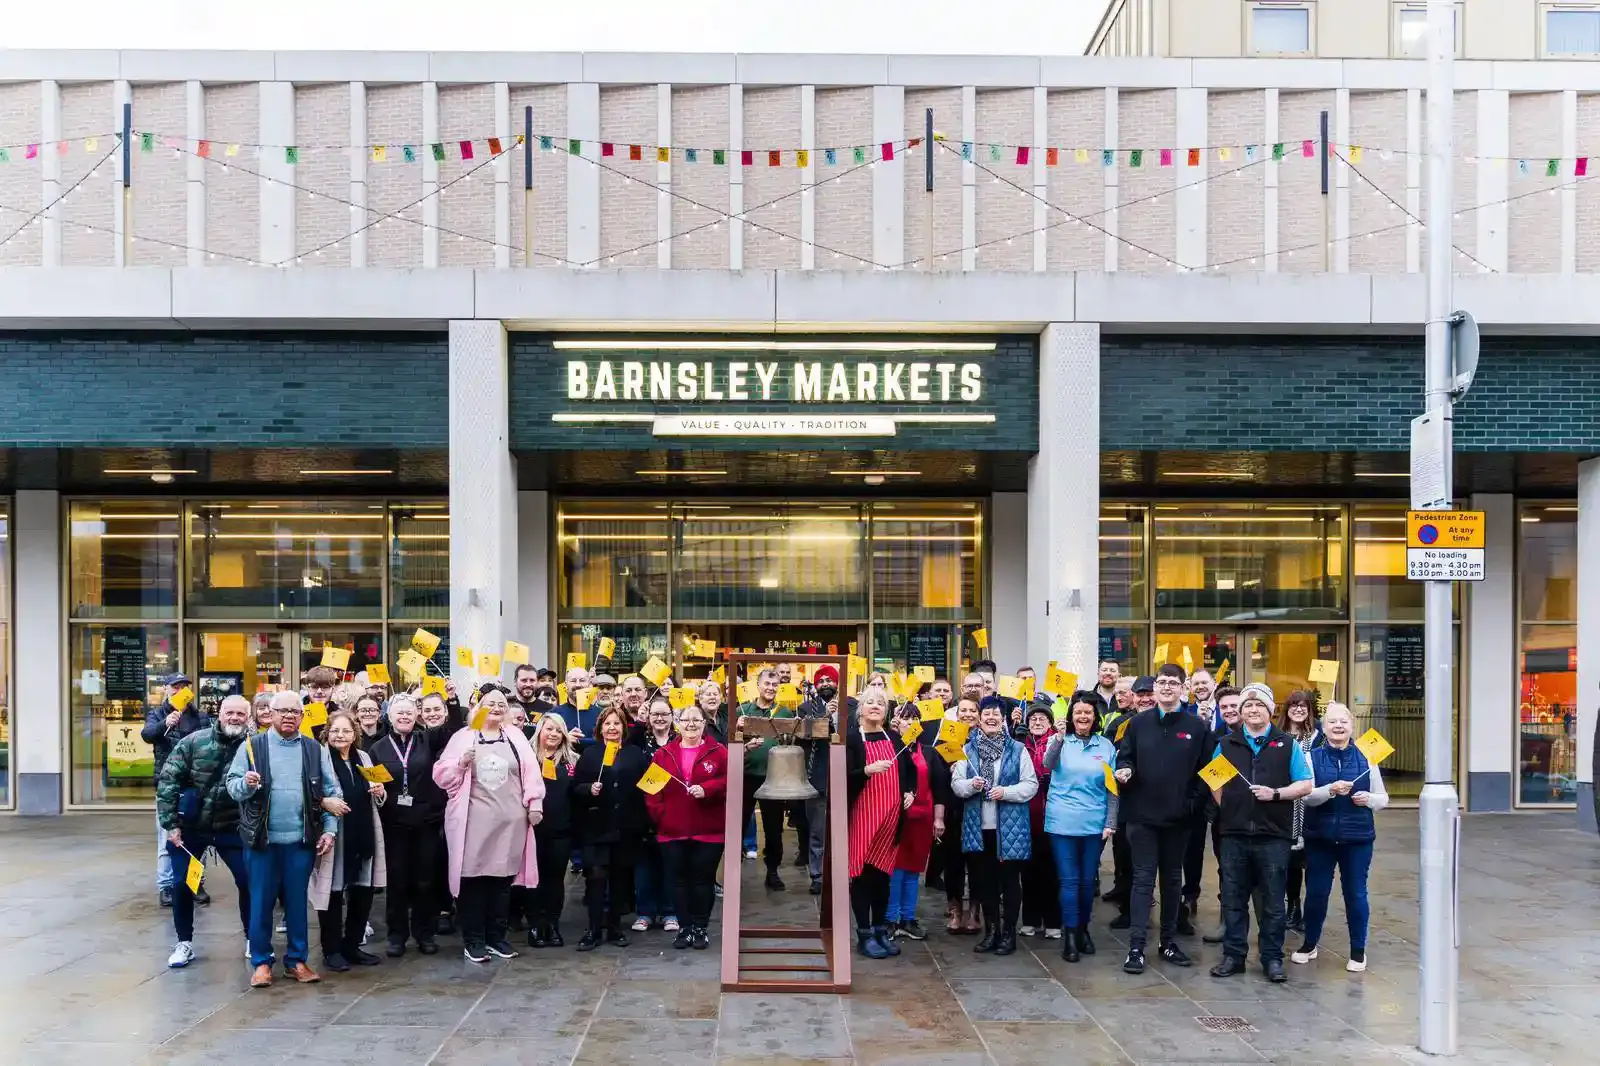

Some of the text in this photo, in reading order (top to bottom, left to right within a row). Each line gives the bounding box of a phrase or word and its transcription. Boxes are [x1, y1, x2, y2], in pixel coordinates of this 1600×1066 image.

[567, 360, 982, 401] BARNSLEY MARKETS
[681, 420, 868, 430] VALUE QUALITY TRADITION
[1410, 561, 1429, 569] 9.30
[1448, 561, 1468, 569] 4.30
[1410, 569, 1429, 577] 6.30
[1449, 569, 1468, 577] 5.00
[782, 640, 800, 648] Price
